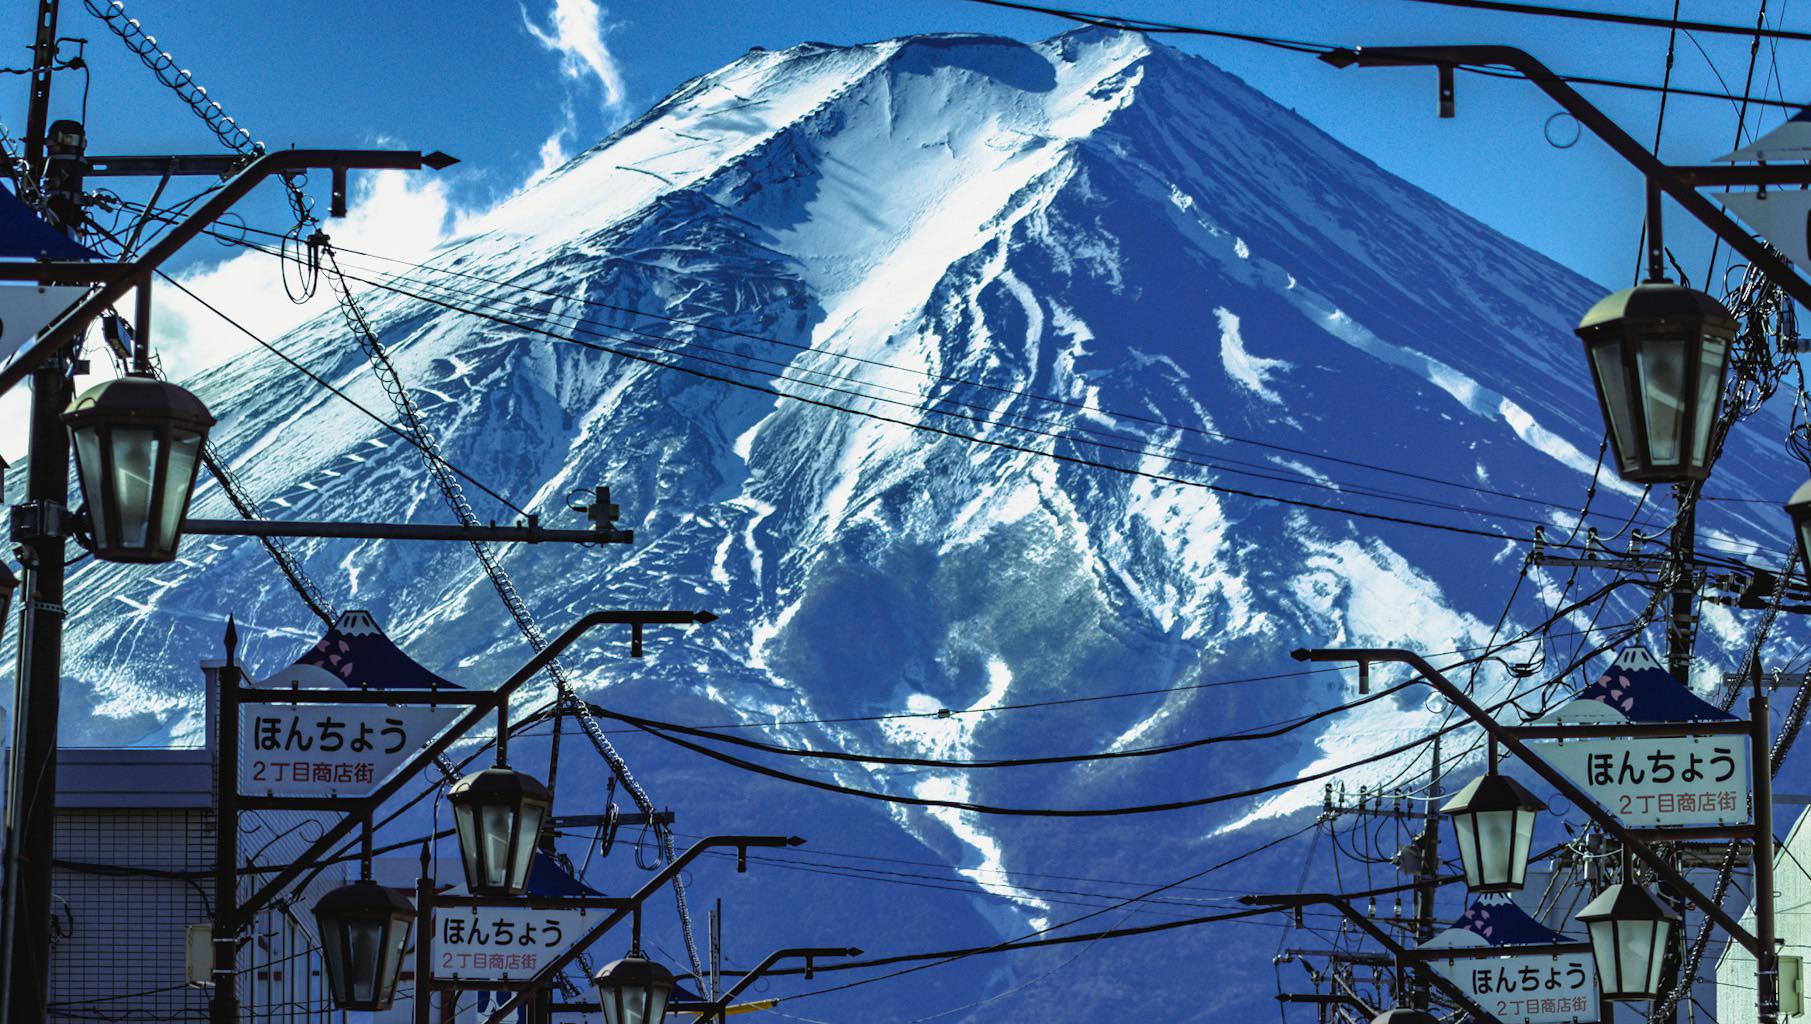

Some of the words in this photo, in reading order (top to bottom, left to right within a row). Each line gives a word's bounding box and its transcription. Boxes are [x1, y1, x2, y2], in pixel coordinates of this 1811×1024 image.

[254, 716, 407, 754] ほんちょう
[253, 761, 374, 785] 2丁目商店街
[1587, 747, 1735, 785] ほんちょう
[1619, 790, 1737, 815] 2丁目商店街
[443, 918, 563, 947] ほんちょう
[442, 952, 537, 974] 2丁目商店街
[1472, 962, 1587, 995] ほんちょう
[1496, 996, 1587, 1017] 2丁目商店街
